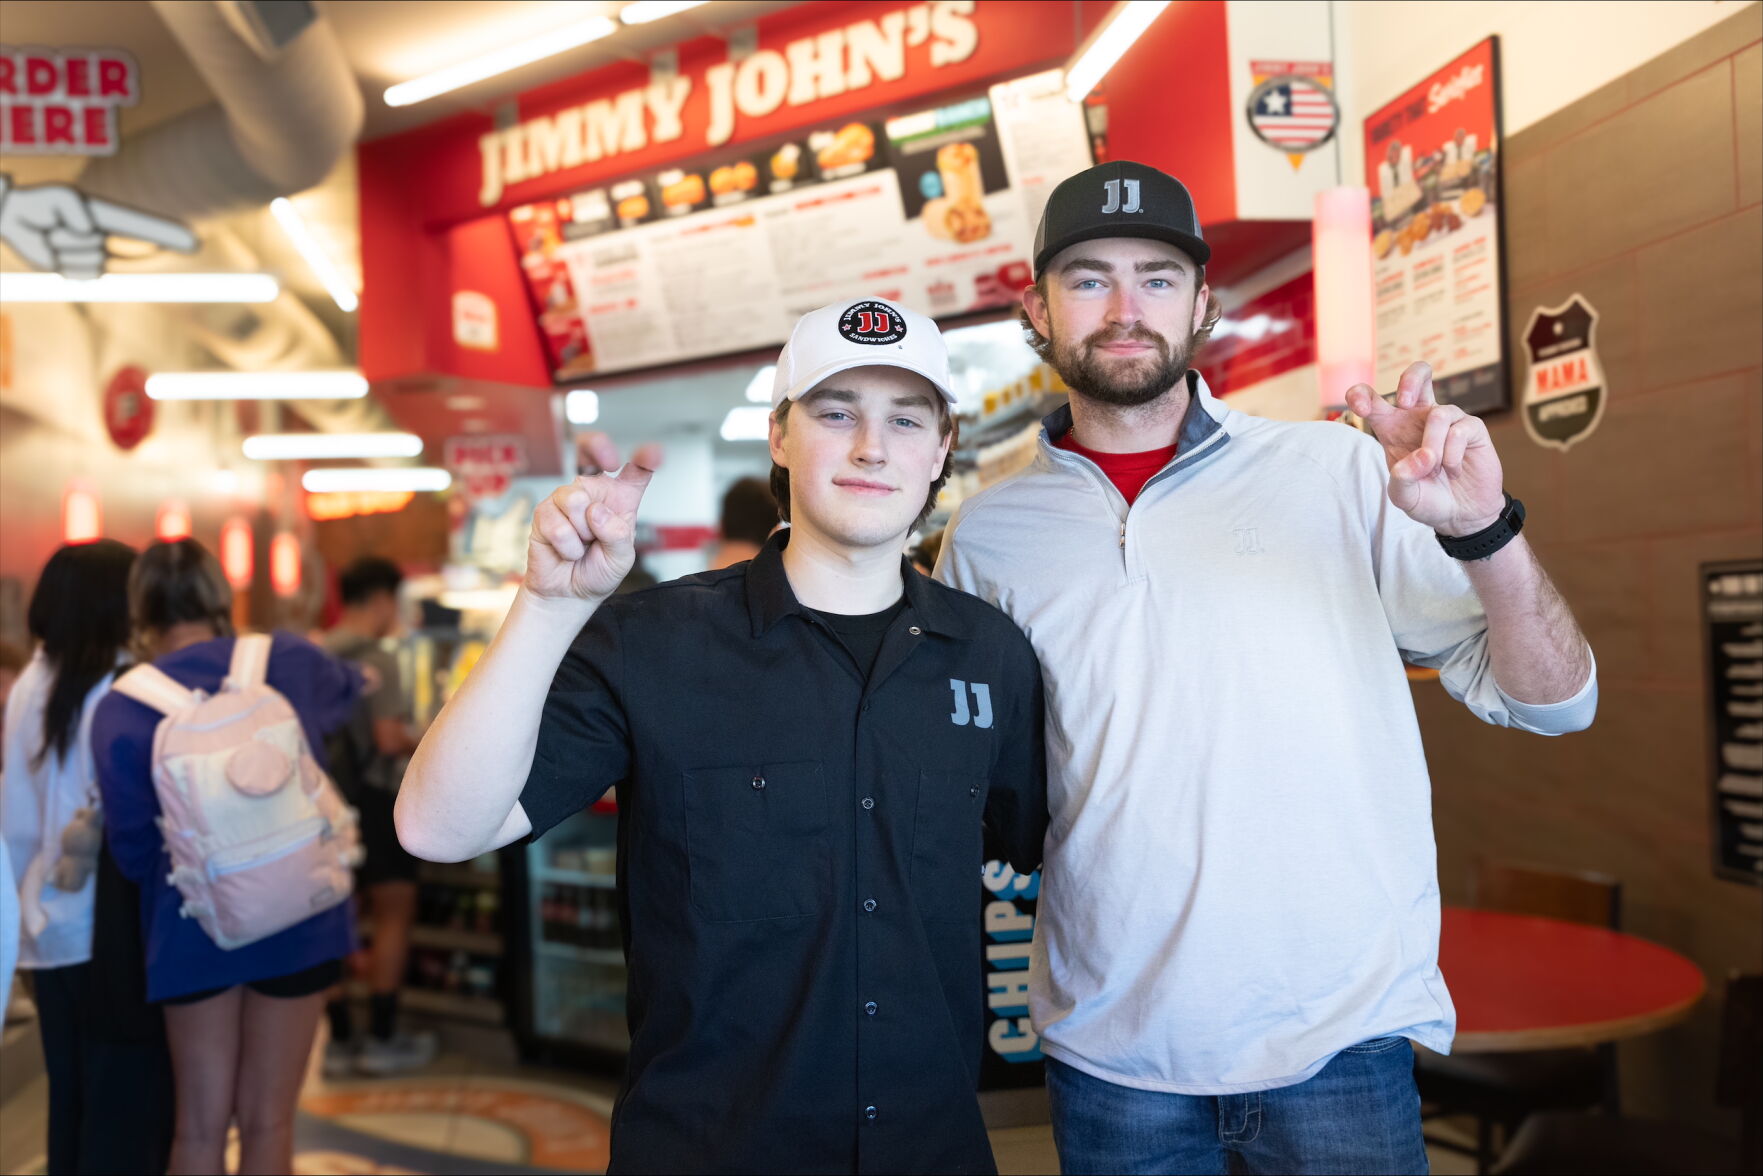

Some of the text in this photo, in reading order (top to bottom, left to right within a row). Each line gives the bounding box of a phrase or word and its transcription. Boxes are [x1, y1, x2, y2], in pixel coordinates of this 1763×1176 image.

[0, 57, 130, 96] RDER
[479, 76, 692, 207] JIMMY
[705, 0, 979, 146] JOHN'S
[0, 105, 109, 145] ERE
[844, 302, 871, 321] JIMMY
[857, 311, 890, 333] JJ
[849, 332, 898, 342] SANDWICHES
[949, 678, 993, 728] JJ
[982, 859, 1043, 1063] CHIPS
